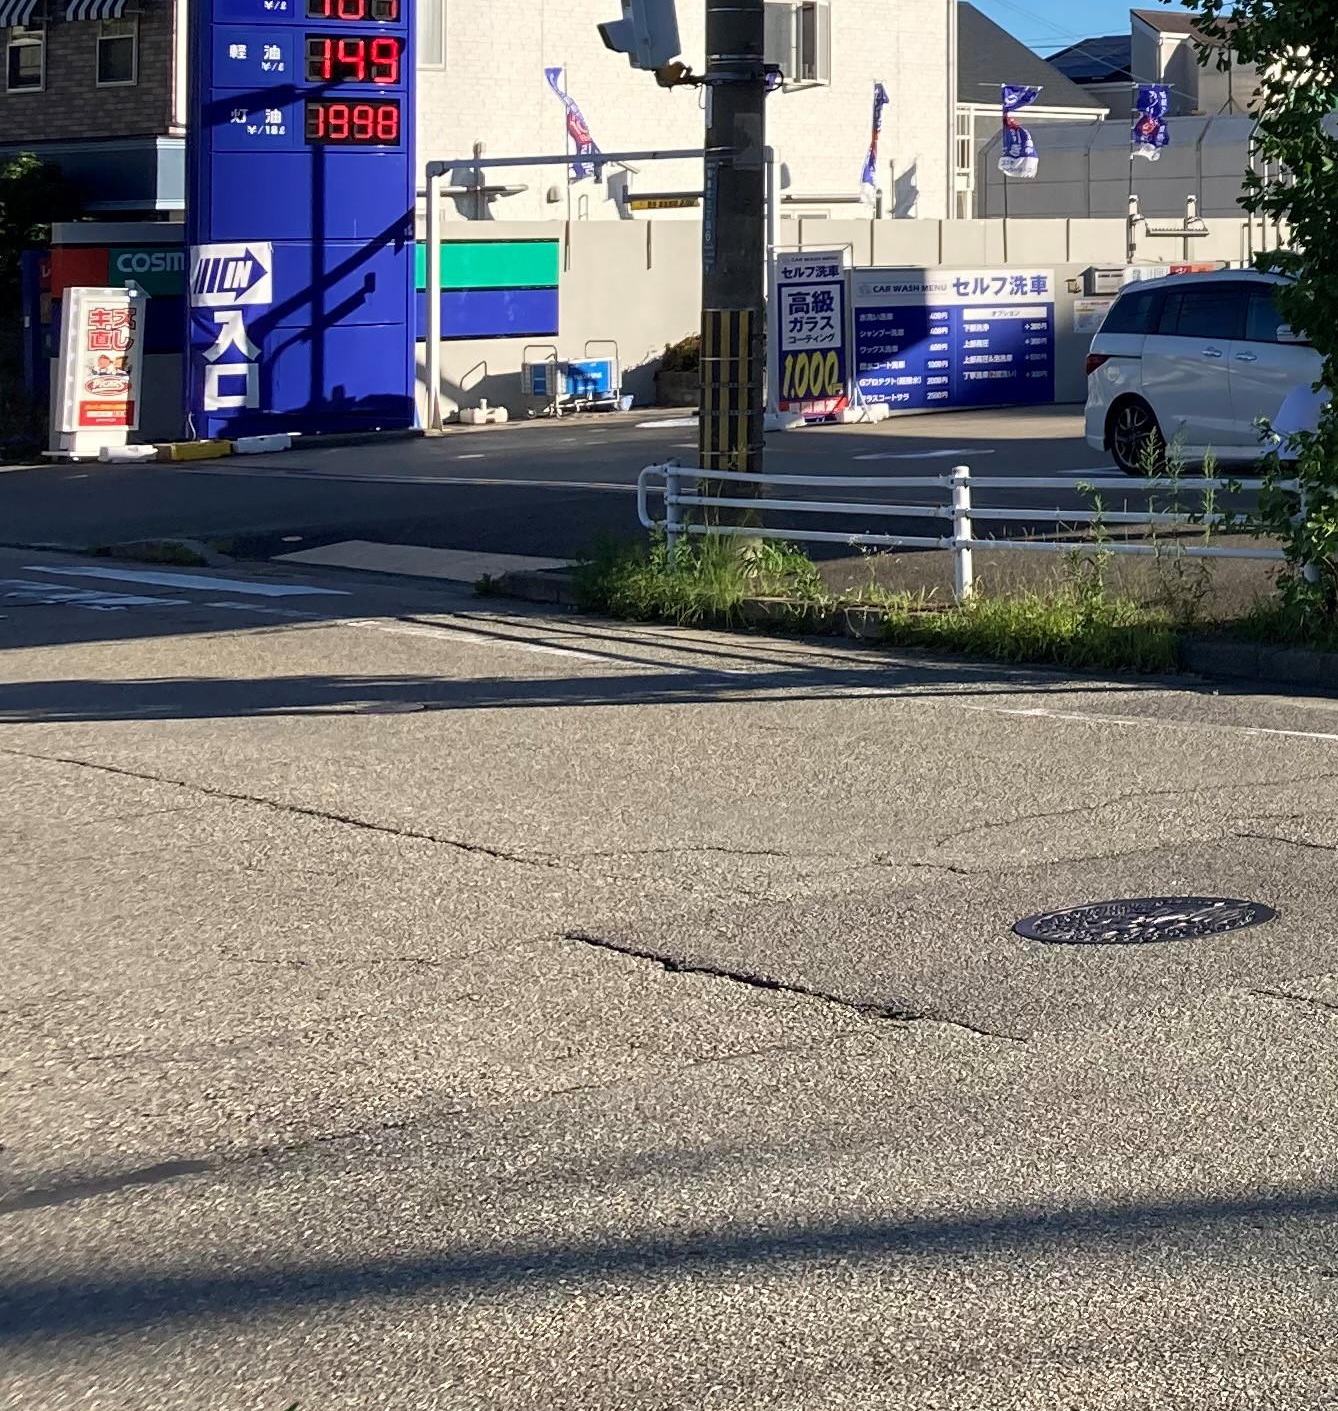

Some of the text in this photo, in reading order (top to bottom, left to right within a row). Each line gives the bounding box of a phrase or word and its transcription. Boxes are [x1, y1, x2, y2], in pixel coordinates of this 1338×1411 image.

[324, 38, 398, 83] 149
[318, 105, 398, 139] 1998
[117, 252, 184, 272] COSM
[781, 265, 839, 278] セルフ洗車
[223, 261, 253, 289] IN
[952, 275, 1048, 296] セルフ洗車
[892, 284, 920, 292] WASH
[788, 290, 835, 315] 高級
[788, 316, 835, 333] ガラス
[788, 333, 835, 344] コーティング
[202, 310, 262, 412] 入口
